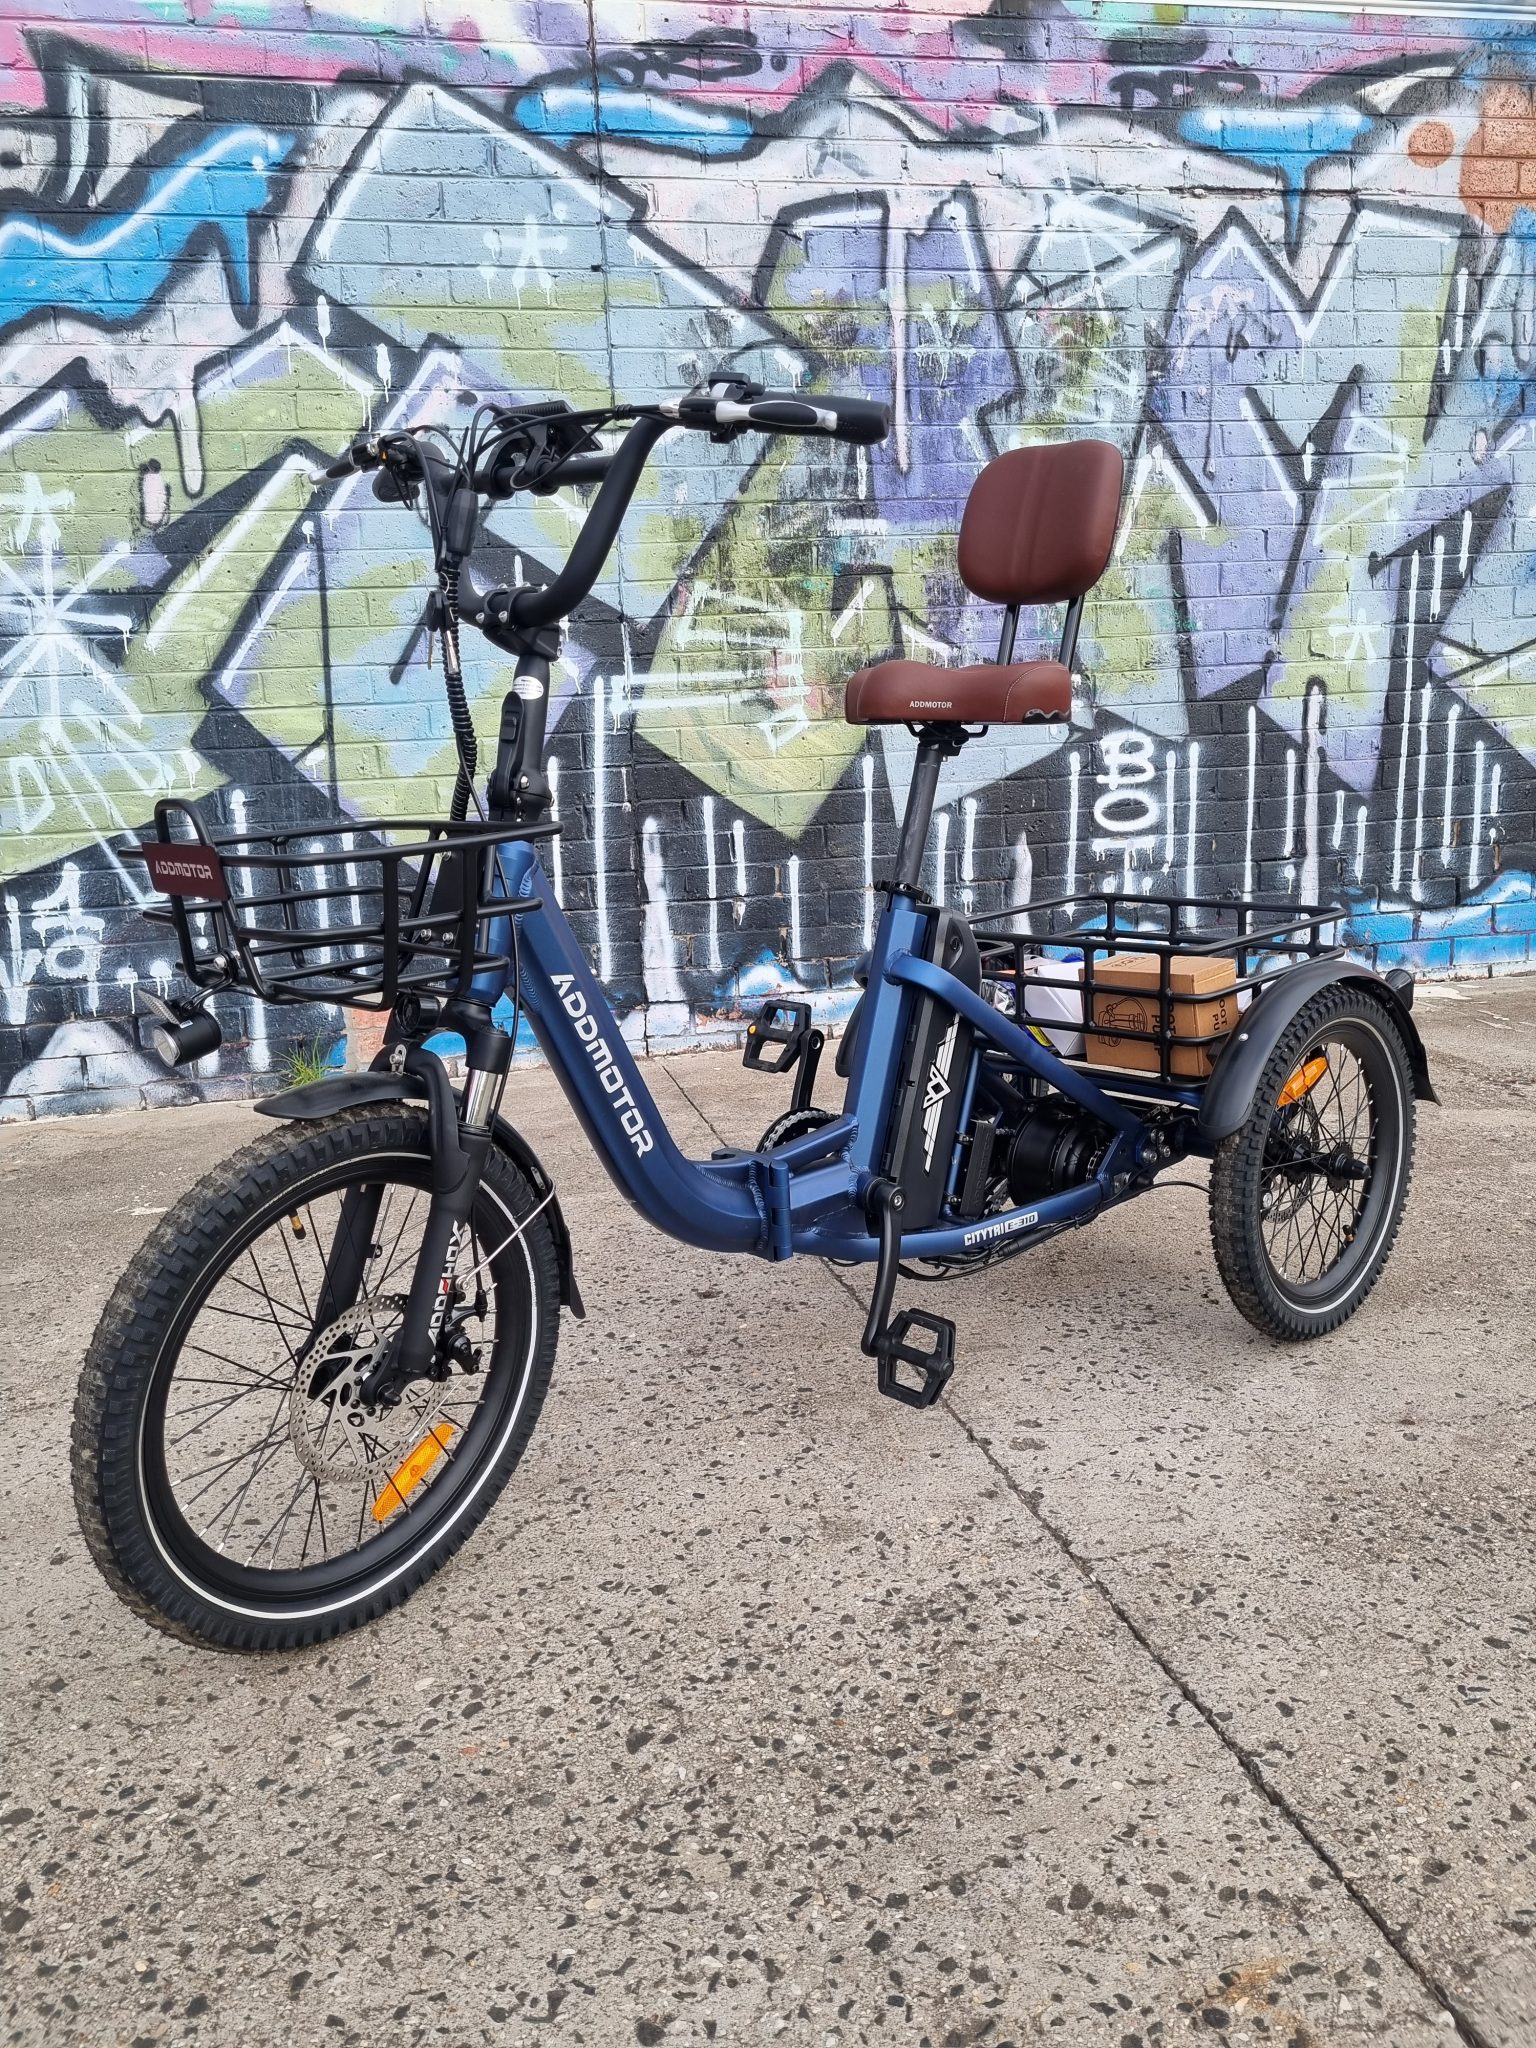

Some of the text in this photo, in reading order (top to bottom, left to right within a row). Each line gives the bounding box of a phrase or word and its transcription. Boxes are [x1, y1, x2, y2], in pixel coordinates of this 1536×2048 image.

[909, 700, 953, 709] ADDMOTOR
[155, 860, 213, 880] ADDMOTOR
[1219, 998, 1228, 1026] OOT
[550, 974, 654, 1158] ADDMOTOR
[964, 1213, 1036, 1246] CITYTRI E-310
